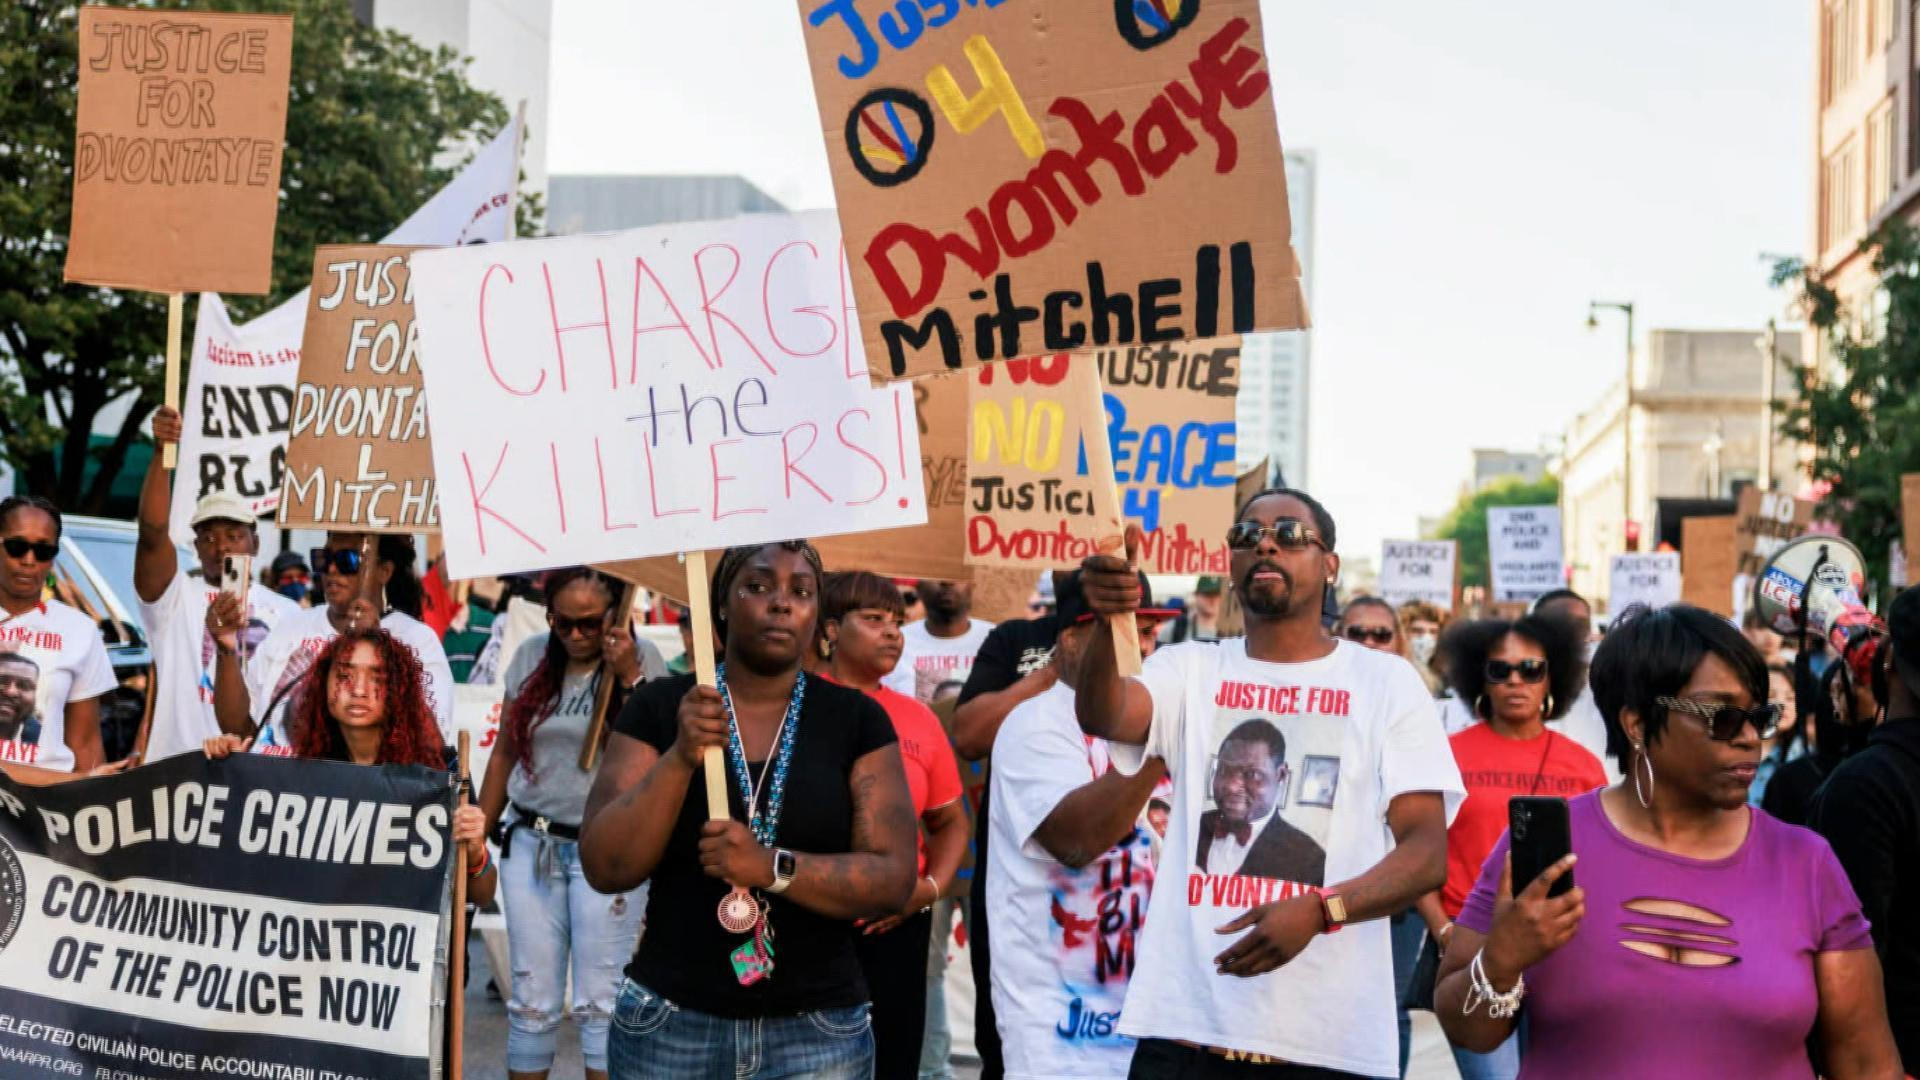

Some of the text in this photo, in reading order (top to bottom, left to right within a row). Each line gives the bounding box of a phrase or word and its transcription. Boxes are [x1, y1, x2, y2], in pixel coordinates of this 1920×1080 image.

[89, 20, 268, 75] JUSTICE
[809, 0, 1002, 79] Jus
[136, 77, 216, 128] FOR
[925, 35, 1045, 159] 4
[77, 133, 275, 187] DVONTAYE
[258, 350, 276, 368] is
[277, 346, 301, 364] th
[202, 383, 294, 438] END
[626, 377, 783, 446] the
[972, 395, 1066, 473] NO
[356, 443, 389, 482] L
[462, 390, 909, 554] KILLERS!
[1123, 488, 1160, 532] 4
[1759, 491, 1796, 523] NO
[1386, 543, 1449, 560] JUSTICE
[1401, 562, 1433, 577] FOR
[1628, 573, 1660, 586] FOR
[36, 631, 63, 650] FOR
[1214, 680, 1352, 717] JUSTICE FOR
[37, 780, 231, 857] POLICE
[238, 788, 448, 870] CRIMES
[1188, 873, 1318, 908] D'VONTA
[42, 874, 421, 973] COMMUNITY CONTROL
[47, 935, 400, 1032] OF THE POLICE NOW
[0, 1014, 75, 1048] ELECTED
[77, 1033, 137, 1061] CIVILIAN
[139, 1046, 197, 1070] POLICE
[1057, 996, 1121, 1040] Jus
